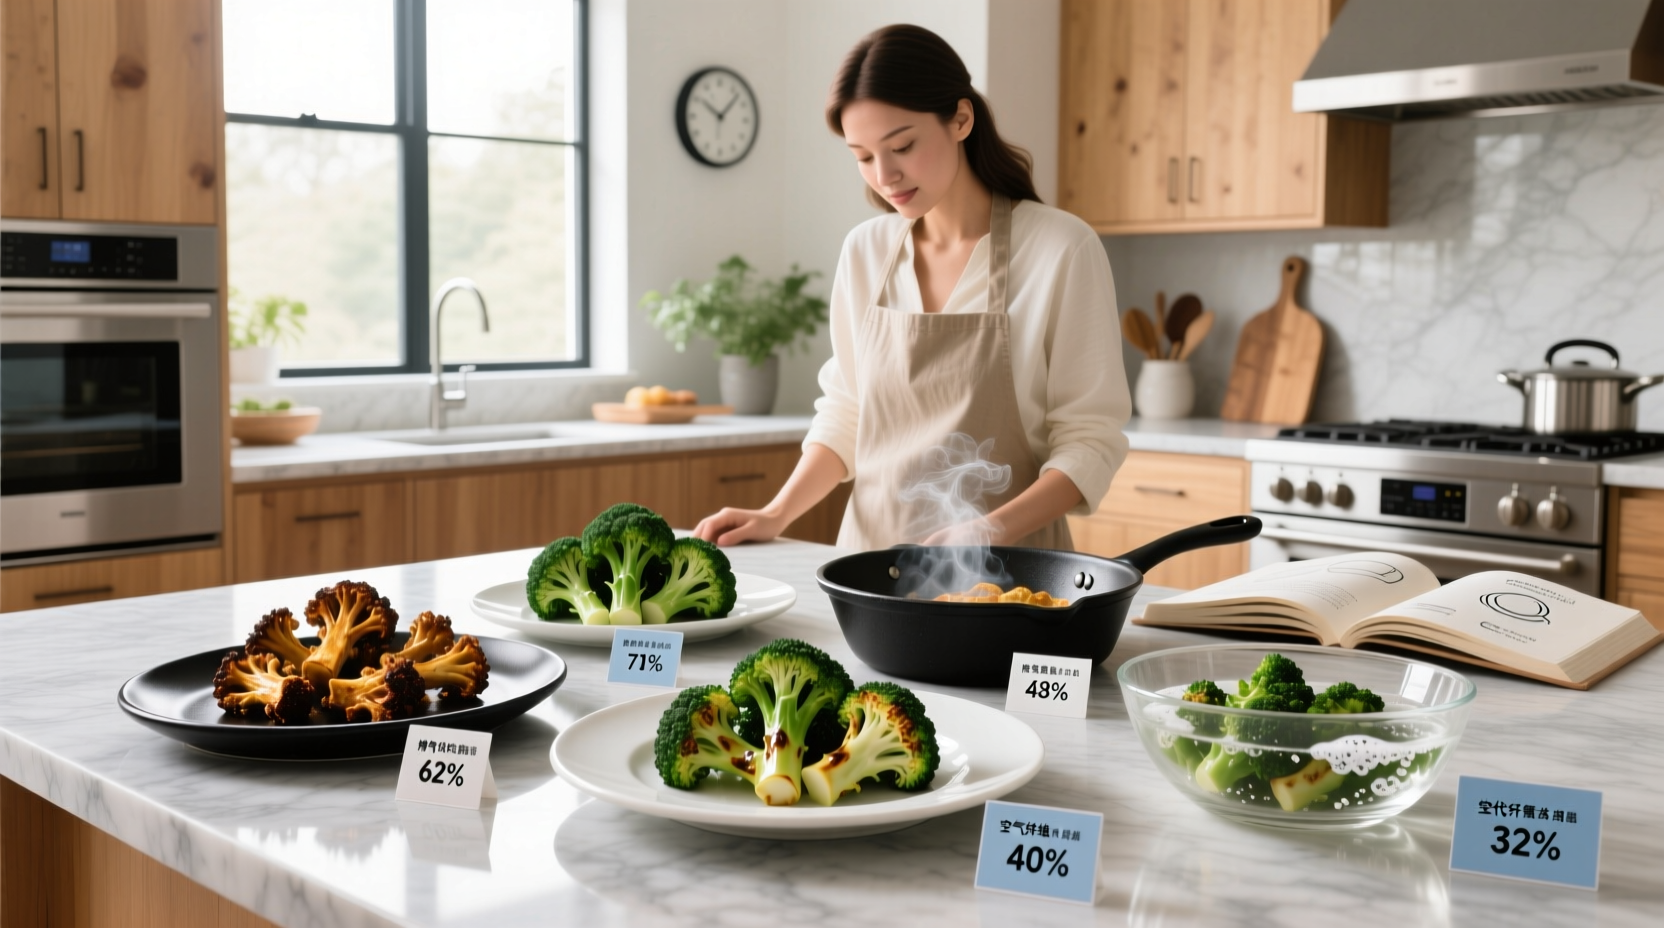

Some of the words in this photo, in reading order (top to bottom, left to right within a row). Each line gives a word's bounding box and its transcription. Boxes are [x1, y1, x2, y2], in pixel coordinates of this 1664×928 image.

[628, 653, 663, 672] 71%
[1025, 680, 1068, 701] 48%
[418, 759, 464, 787] 62%
[1490, 825, 1561, 861] 32%
[1006, 844, 1069, 877] 40%
